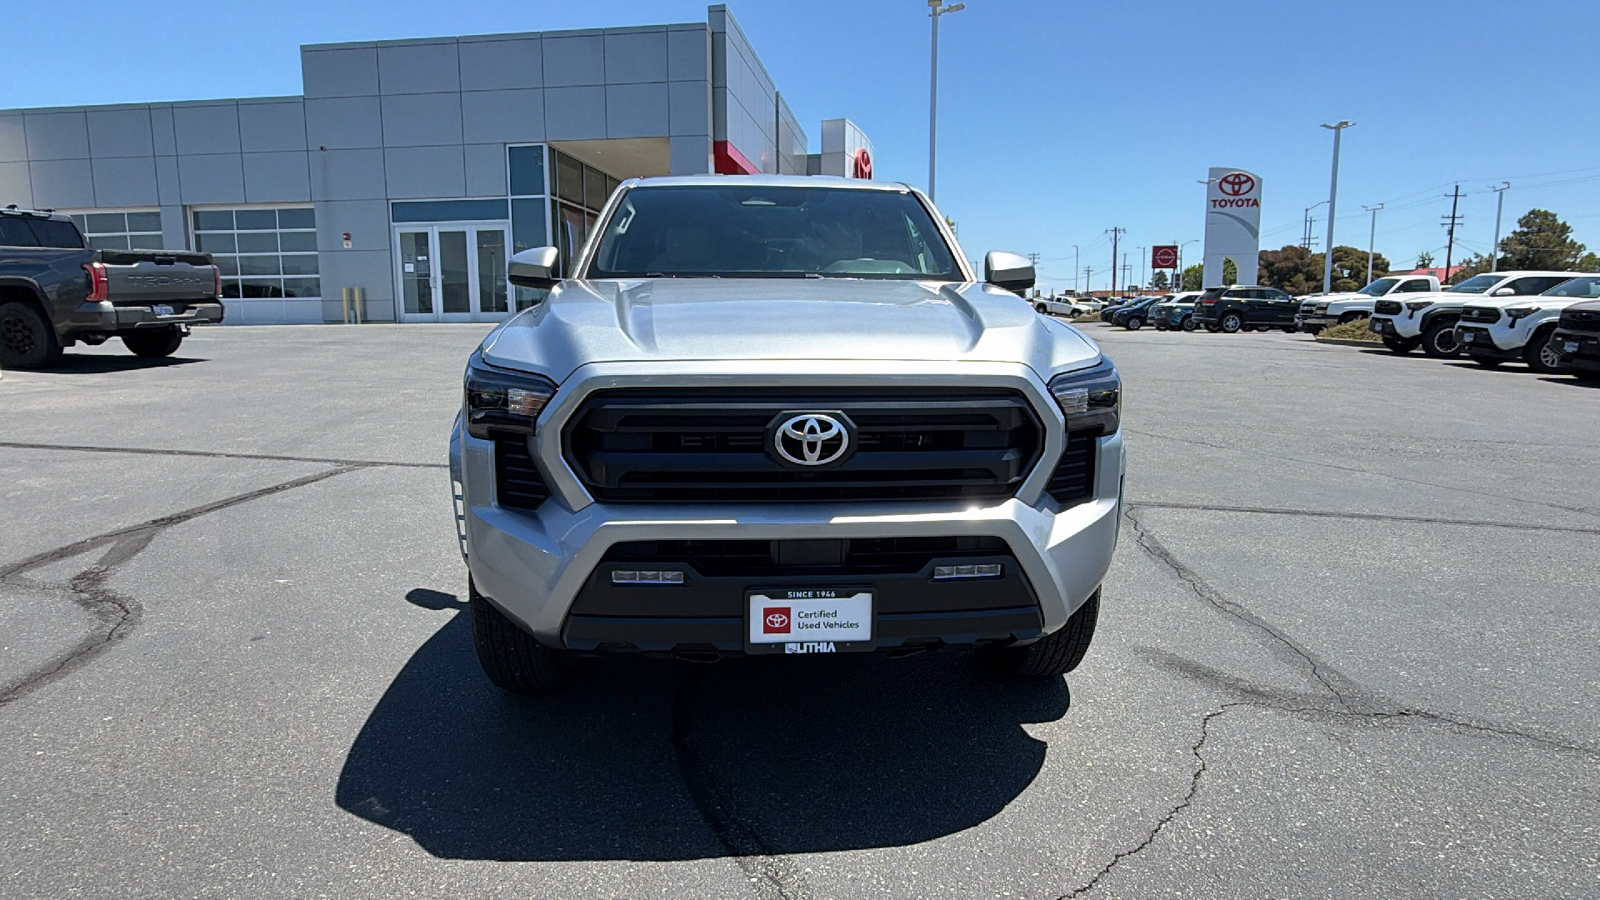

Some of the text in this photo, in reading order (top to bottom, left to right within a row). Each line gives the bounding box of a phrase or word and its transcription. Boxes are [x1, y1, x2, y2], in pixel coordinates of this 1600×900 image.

[1211, 198, 1259, 208] TOYOTA
[128, 275, 170, 288] TRD
[798, 610, 838, 618] Certified
[798, 620, 860, 630] Used Vehicles
[798, 642, 836, 653] LITHIA
